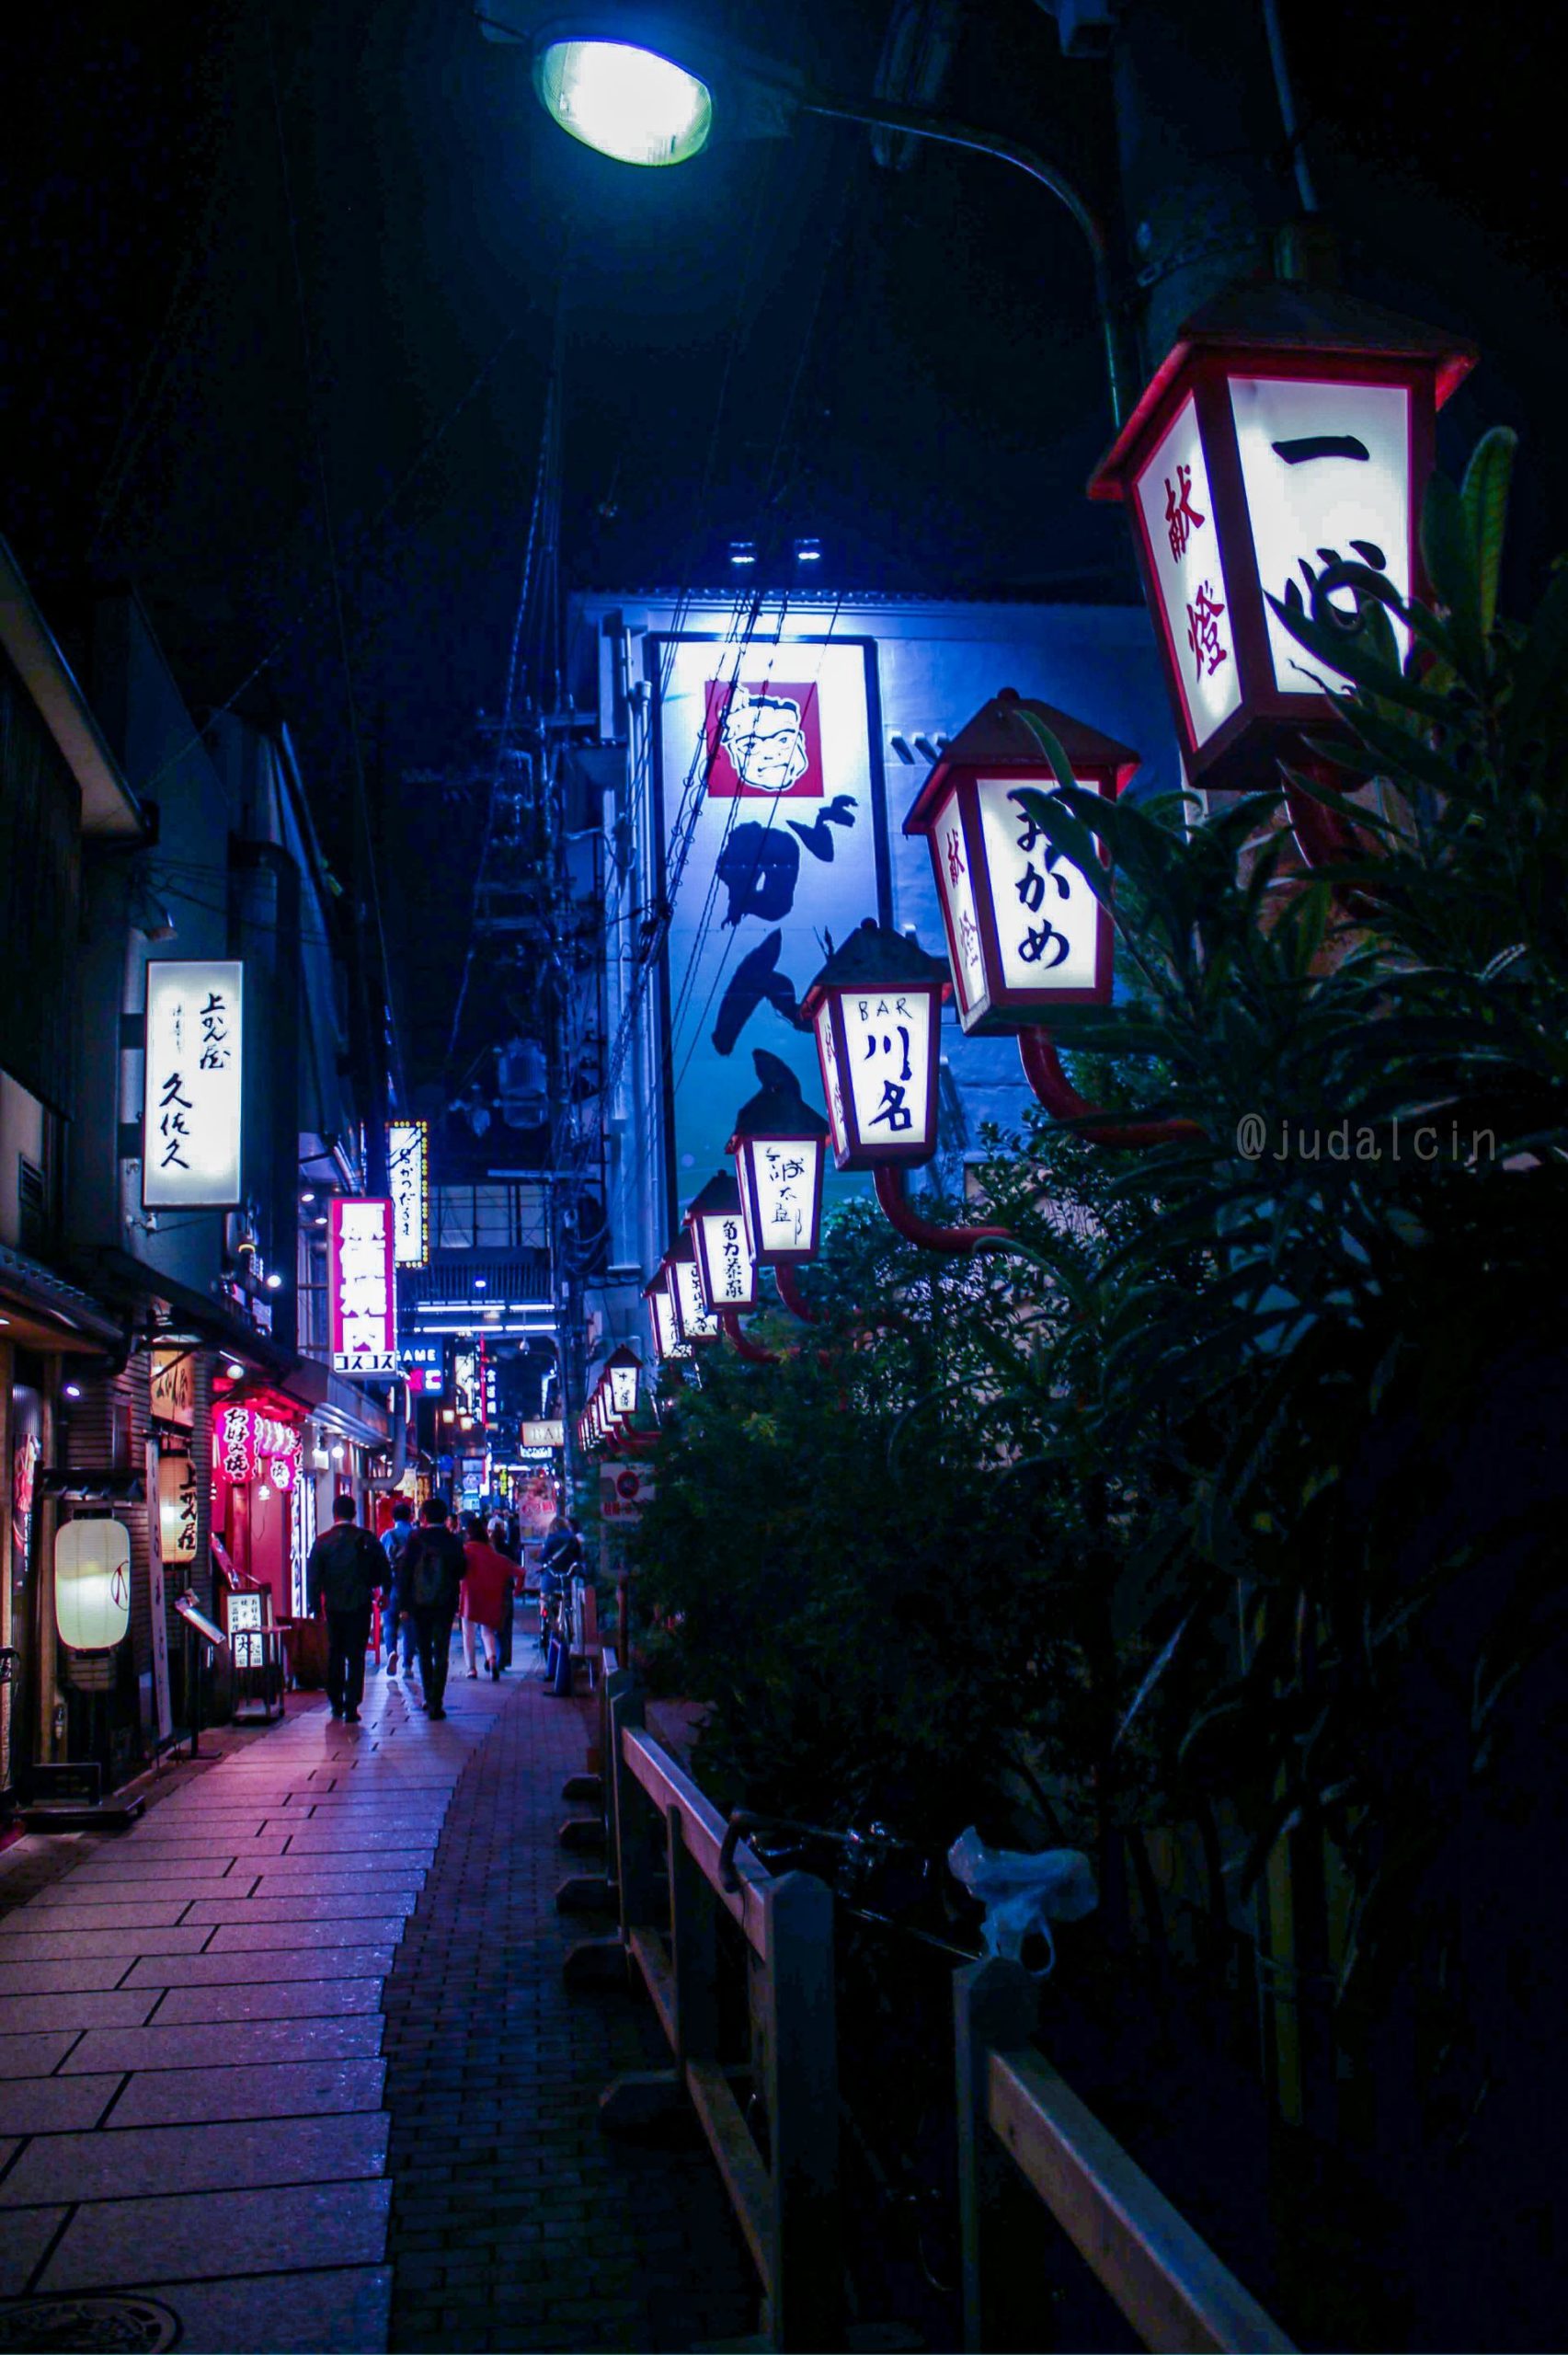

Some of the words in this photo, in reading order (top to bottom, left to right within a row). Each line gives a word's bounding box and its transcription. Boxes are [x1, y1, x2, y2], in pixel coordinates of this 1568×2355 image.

[858, 996, 913, 1022] BAR
[864, 1025, 913, 1132] 川名
[159, 1073, 193, 1169] 久佐久
[336, 1354, 393, 1371] コスコス
